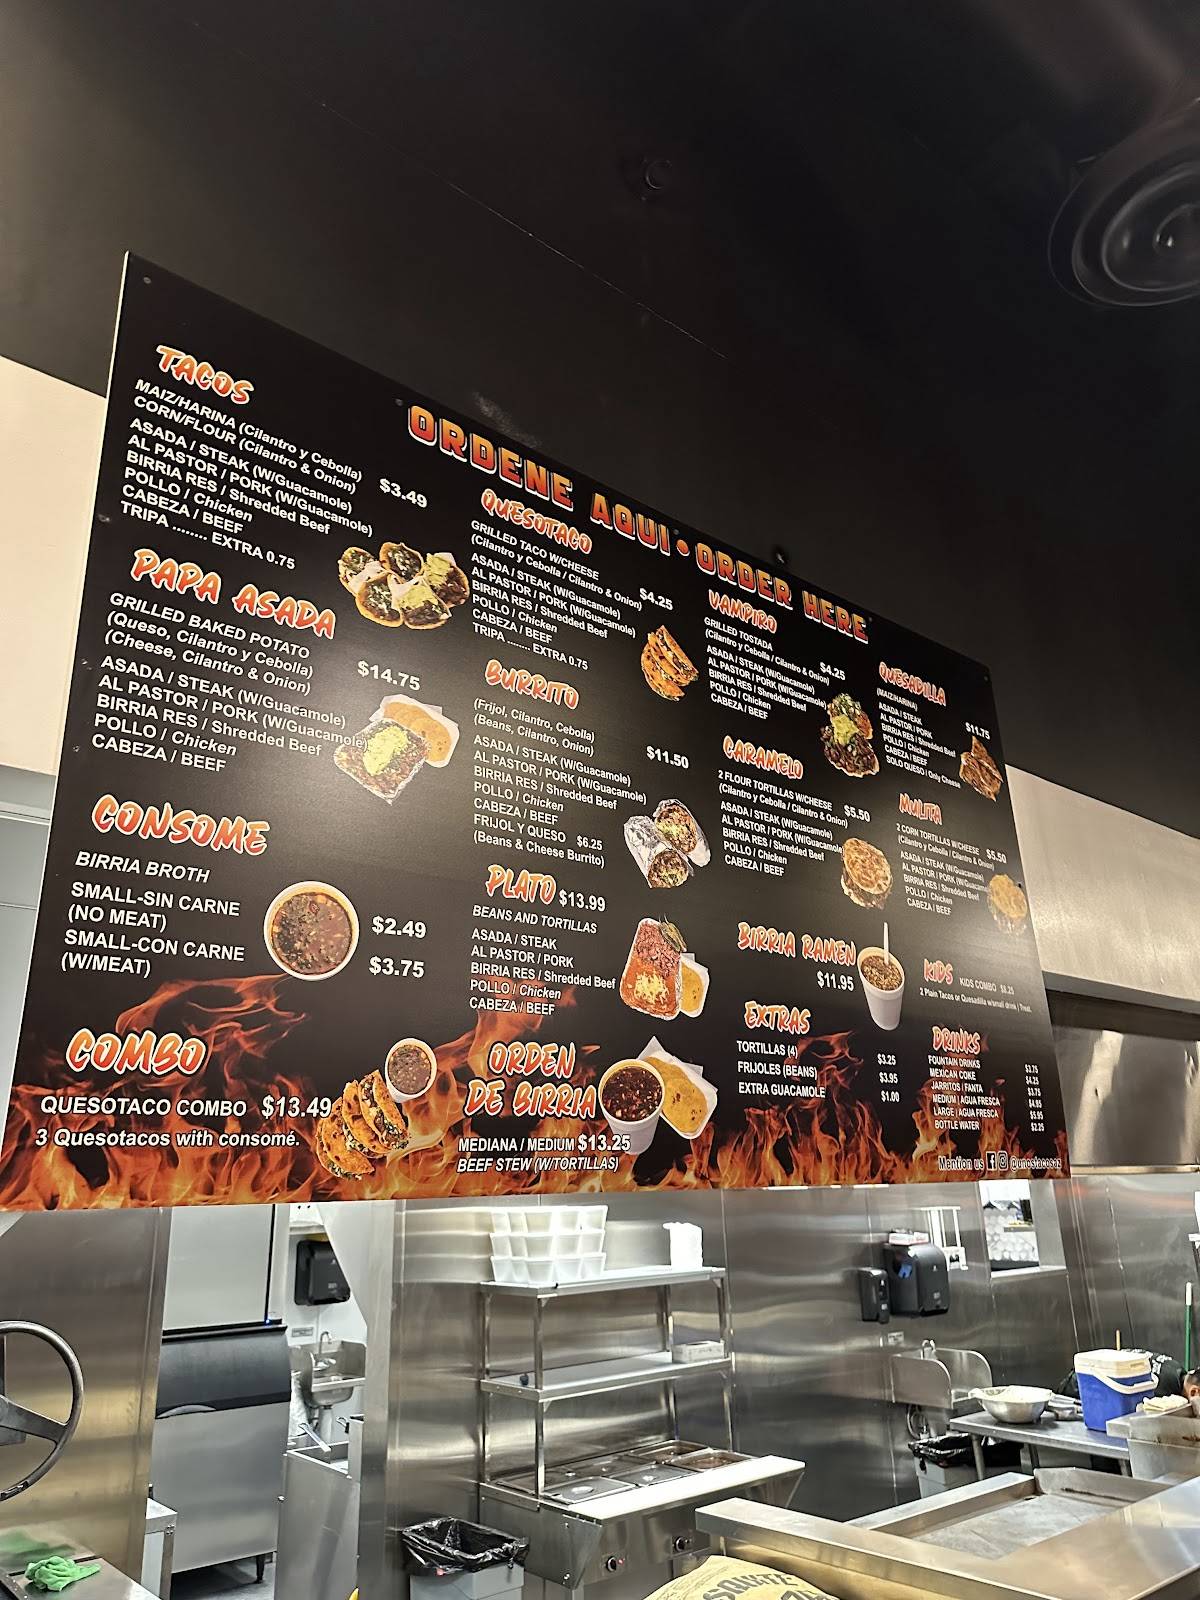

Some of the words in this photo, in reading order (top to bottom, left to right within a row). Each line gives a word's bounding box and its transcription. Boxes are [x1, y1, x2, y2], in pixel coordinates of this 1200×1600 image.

[156, 345, 254, 404] TACOS
[134, 396, 236, 444] CORN/FLOUR
[239, 438, 297, 468] (Cilantro
[300, 462, 310, 475] &
[314, 468, 356, 494] Onion)
[136, 379, 235, 429] MAIZ/HARINA
[238, 422, 296, 453] (Cilantro
[298, 448, 309, 464] y
[311, 452, 362, 482] Cebolla)
[130, 418, 187, 448] ASADA
[199, 444, 249, 472] STEAK
[253, 465, 352, 514] (W/Guacamole)
[124, 467, 181, 495] POLLO
[194, 492, 252, 522] Chicken
[127, 450, 182, 480] BIRRIA
[185, 471, 217, 492] RES
[229, 488, 296, 522] Shredded
[299, 514, 330, 534] Beef
[128, 434, 150, 451] AL
[154, 443, 217, 476] PASTOR
[229, 471, 272, 497] PORK
[275, 490, 372, 537] (W/Guacamole)
[380, 478, 427, 508] $3.49
[122, 484, 190, 517] CABEZA
[202, 511, 243, 533] BEEF
[408, 406, 574, 512] ORDENE
[590, 493, 670, 556] AQUI
[695, 543, 793, 610] ORDER
[802, 590, 868, 644] HERE
[481, 488, 592, 554] QUESOTACO
[121, 500, 168, 527] TRIPA
[212, 532, 263, 559] EXTRA
[266, 550, 295, 569] 0.75
[471, 520, 517, 545] GRILLED
[520, 539, 547, 558] TACO
[549, 552, 599, 580] W/CHEESE
[130, 548, 221, 604] PAPA
[232, 584, 336, 640] ASADA
[639, 588, 673, 610] $4.25
[110, 592, 185, 622] GRILLED
[188, 615, 246, 640] BAKED
[249, 632, 309, 658] POTATO
[708, 589, 777, 634] VAMPIRO
[107, 611, 170, 640] (Queso,
[176, 630, 237, 656] Cilantro
[240, 649, 252, 662] y
[255, 652, 313, 679] Cebolla)
[704, 616, 738, 636] GRILLED
[739, 630, 773, 651] TOSTADA
[105, 629, 176, 660] (Cheese,
[182, 650, 243, 675] Cilantro
[247, 667, 258, 680] &
[263, 671, 310, 696] Onion)
[358, 660, 420, 690] $14.75
[820, 662, 846, 680] $4.25
[485, 659, 579, 710] BURRITO
[879, 662, 946, 706] QUESADILLA
[555, 722, 595, 743] Cebolla)
[561, 738, 594, 757] Onion)
[965, 722, 990, 740] $11.75
[646, 746, 689, 768] $11.50
[723, 735, 804, 780] CARAMELO
[718, 769, 724, 779] 2
[724, 771, 752, 787] FLOUR
[753, 779, 794, 799] TORTILLAS
[795, 792, 832, 811] W/CHEESE
[92, 794, 270, 856] CONSOME
[844, 804, 870, 822] $5.50
[899, 793, 942, 826] MULITA
[474, 813, 515, 832] FRIJOL
[516, 822, 525, 834] Y
[527, 825, 566, 842] QUESO
[576, 835, 602, 850] $6.25
[474, 830, 512, 848] (Beans
[514, 838, 524, 850] &
[526, 840, 564, 858] Cheese
[567, 848, 604, 868] Burrito)
[76, 851, 140, 873] BIRRIA
[145, 861, 210, 882] BROTH
[72, 882, 173, 908] SMALL-SIN
[178, 896, 240, 916] CARNE
[485, 864, 556, 905] PLATO
[559, 889, 605, 911] $13.99
[68, 904, 104, 923] (NO
[109, 908, 166, 932] MEAT)
[372, 916, 426, 938] $2.49
[472, 904, 512, 921] BEANS
[514, 911, 538, 925] AND
[541, 915, 597, 933] TORTILLAS
[65, 929, 178, 954] SMALL-CON
[183, 942, 244, 961] CARNE
[737, 922, 796, 958] BIRRIA
[801, 934, 856, 968] RAMEN
[62, 952, 150, 977] (W/MEAT)
[369, 956, 424, 978] $3.75
[817, 970, 854, 991] $11.95
[924, 958, 954, 985] KIDS
[744, 1000, 811, 1035] EXTRAS
[66, 1028, 206, 1075] COMBO
[736, 1040, 786, 1055] TORTILLAS
[787, 1045, 798, 1059] (4)
[932, 1025, 980, 1055] DRINKS
[490, 1041, 576, 1078] ORDEN
[737, 1060, 781, 1075] FRIJOLES
[782, 1064, 818, 1080] (BEANS)
[877, 1053, 896, 1065] $3.25
[928, 1054, 958, 1066] FOUNTAIN
[958, 1058, 981, 1069] DRINKS
[738, 1081, 770, 1095] EXTRA
[770, 1084, 825, 1098] GUACAMOLE
[879, 1071, 898, 1084] $3.95
[41, 1096, 170, 1115] QUESOTACO
[177, 1099, 246, 1116] COMBO
[262, 1095, 334, 1121] $13.49
[464, 1078, 505, 1116] DE
[512, 1081, 596, 1118] BIRRIA
[880, 1090, 900, 1102] $1.00
[35, 1128, 47, 1148] 3
[54, 1128, 169, 1147] Quesotacos
[176, 1128, 214, 1146] with
[219, 1130, 299, 1146] consomé.
[934, 1119, 958, 1130] BOTTLE
[958, 1120, 980, 1130] WATER
[458, 1137, 517, 1155] MEDIANA
[527, 1137, 574, 1154] MEDIUM
[577, 1132, 630, 1153] $13.25
[457, 1157, 493, 1172] BEEF
[495, 1157, 532, 1172] STEW
[534, 1156, 619, 1173] (W/TORTILLAS)
[938, 1156, 972, 1170] Mention
[973, 1158, 984, 1170] us
